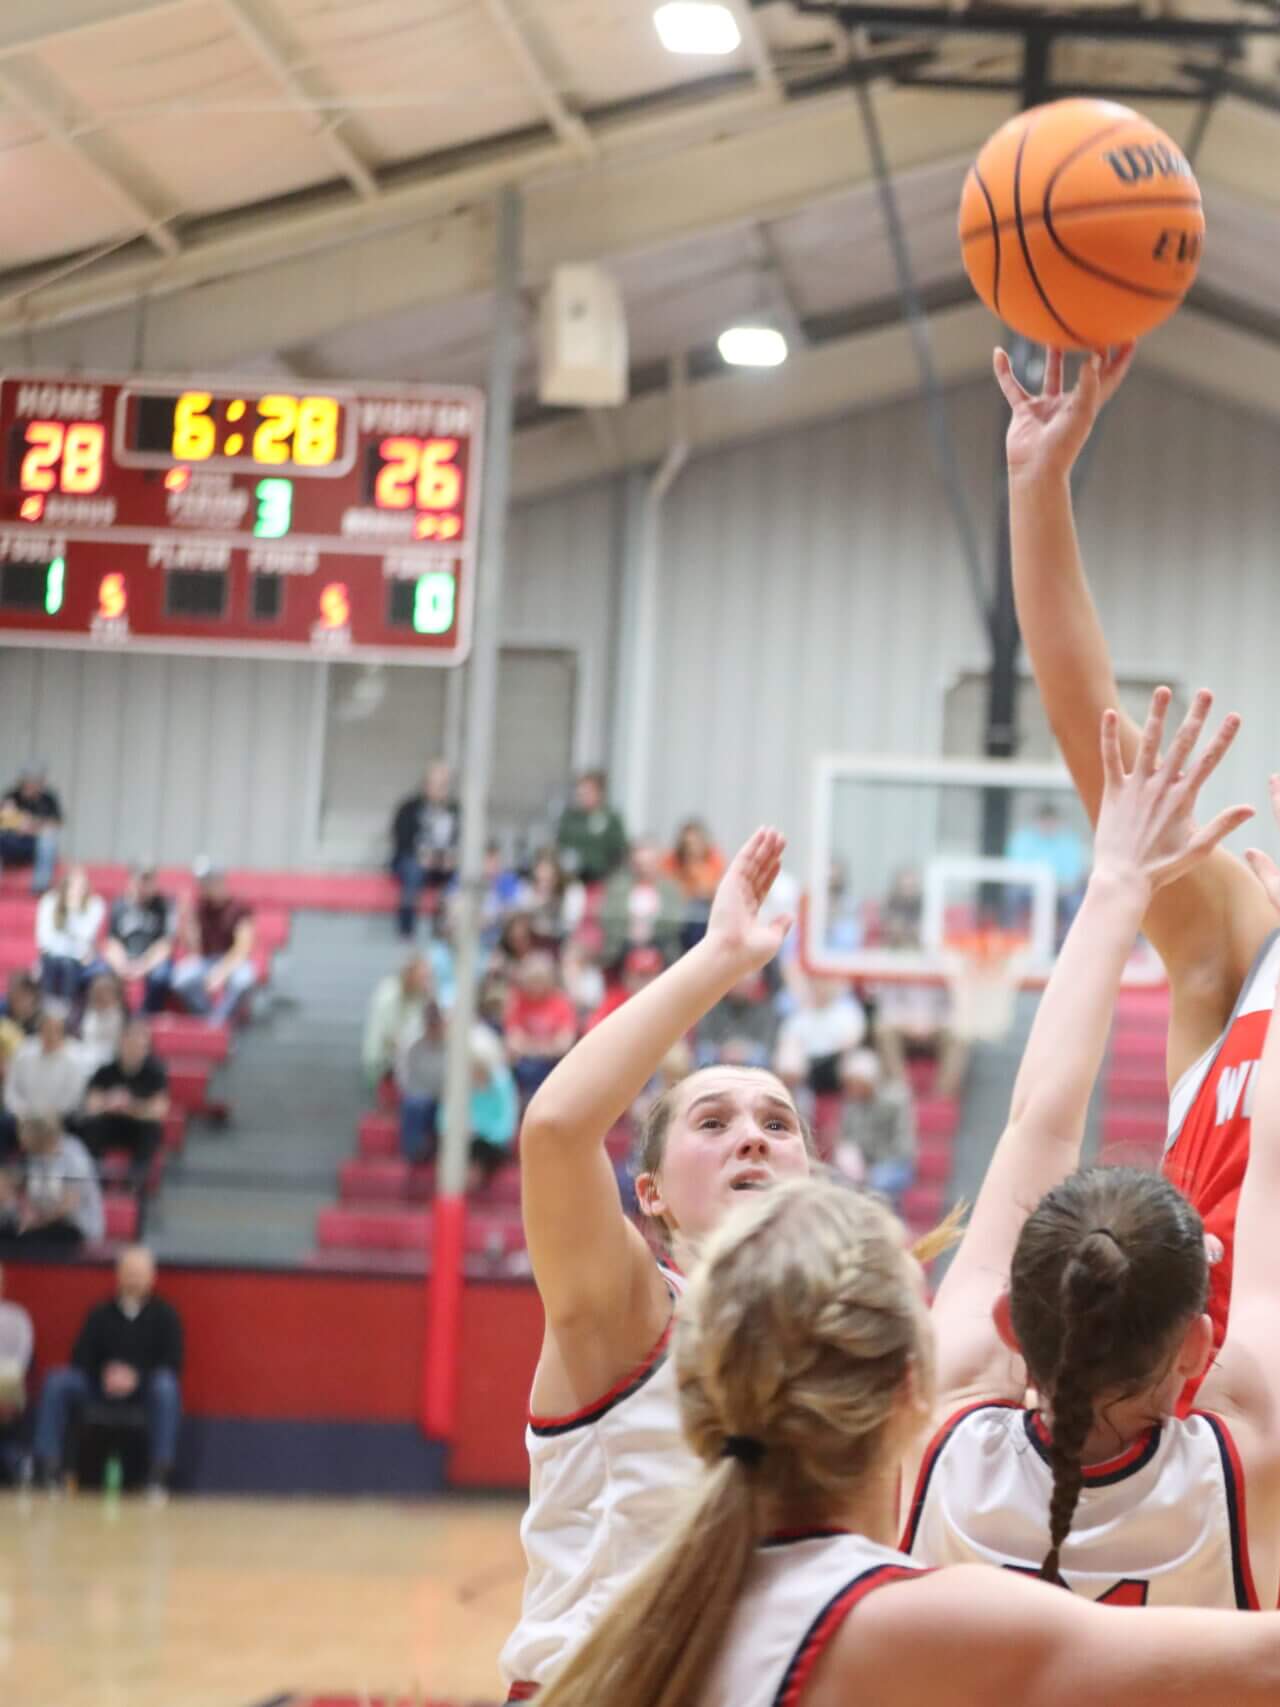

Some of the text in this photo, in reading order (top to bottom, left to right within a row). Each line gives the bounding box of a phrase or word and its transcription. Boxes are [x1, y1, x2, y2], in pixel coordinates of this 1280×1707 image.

[16, 386, 102, 418] HOME
[172, 391, 338, 466] 6:28
[20, 420, 105, 494] 28
[375, 437, 463, 510] 26
[253, 478, 293, 538] 3
[46, 556, 64, 615] 1
[413, 572, 455, 634] 0
